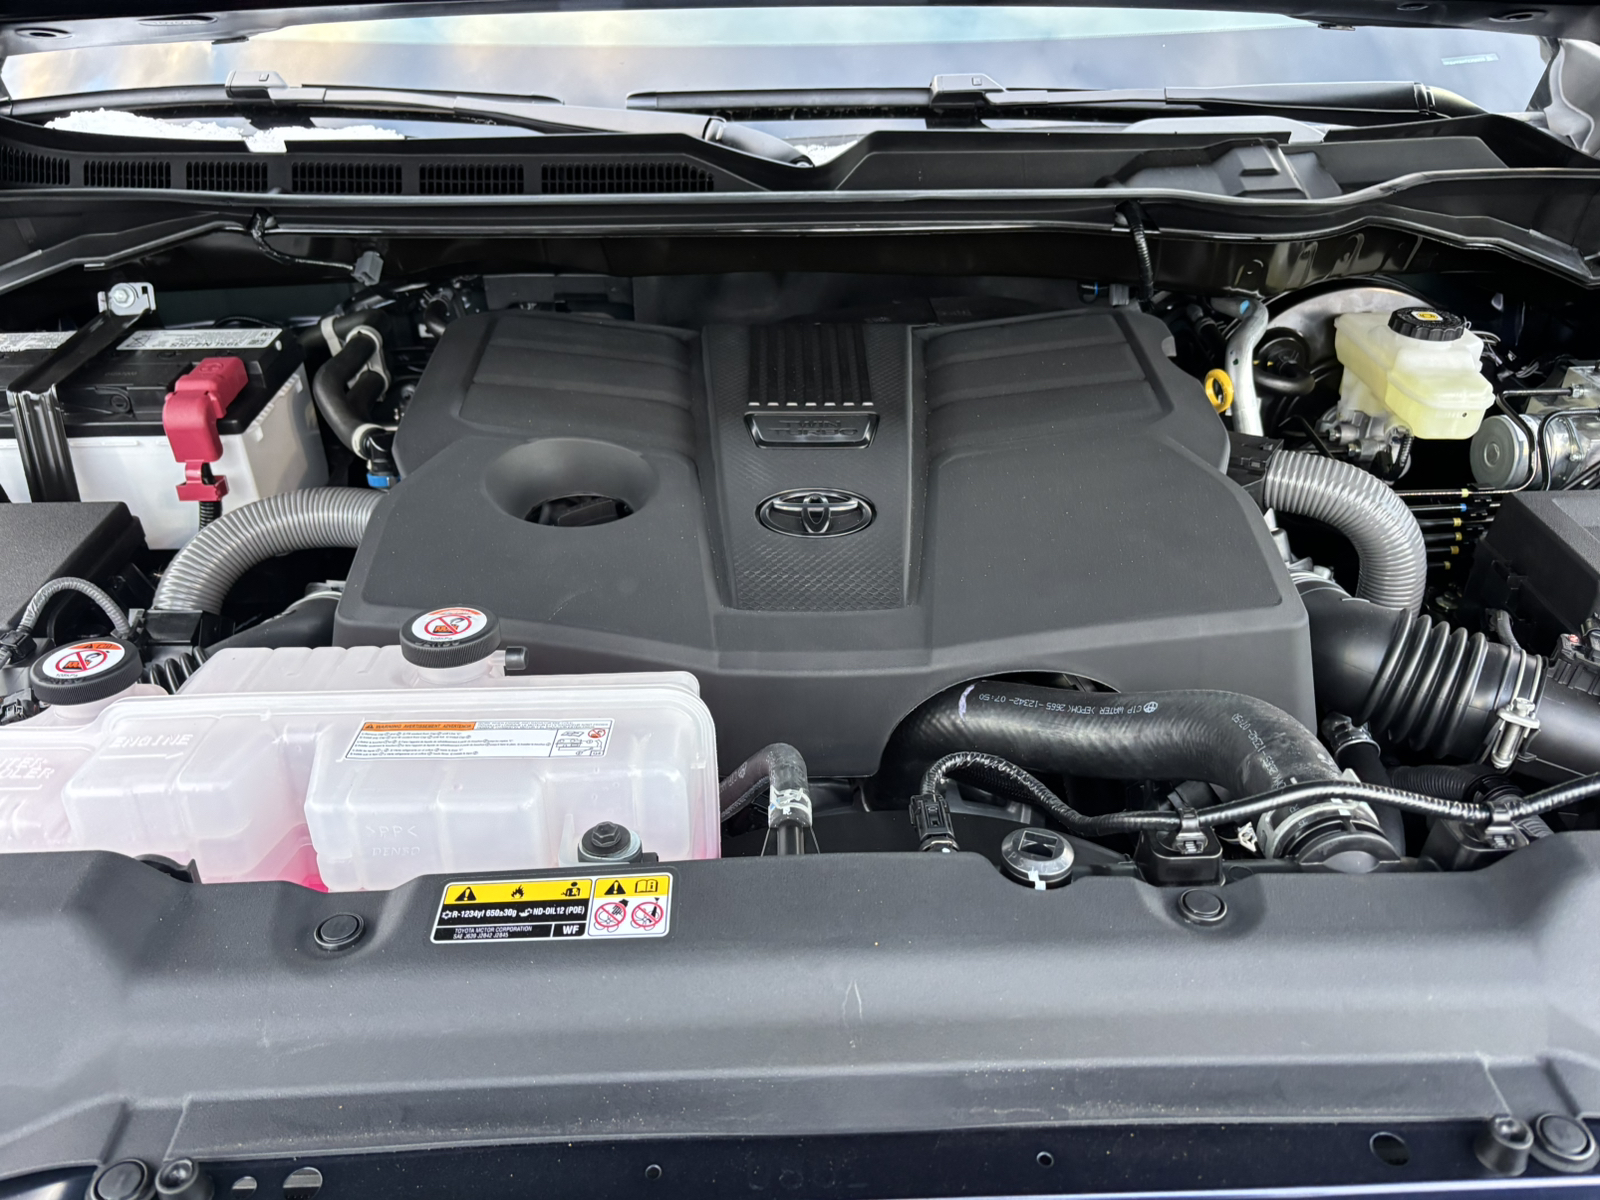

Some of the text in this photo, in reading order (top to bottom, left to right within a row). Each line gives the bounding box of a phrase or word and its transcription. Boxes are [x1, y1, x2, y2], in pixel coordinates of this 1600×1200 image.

[779, 420, 841, 428] TWIN
[768, 428, 858, 436] TURBO
[978, 693, 1007, 703] 07:50
[1099, 706, 1125, 715] WATER
[109, 734, 194, 748] ENGINE
[372, 846, 421, 857] DENSO
[451, 909, 485, 919] R-1234yf
[485, 908, 517, 918] 650±30g
[565, 905, 585, 916] (POE)
[562, 925, 580, 935] WF
